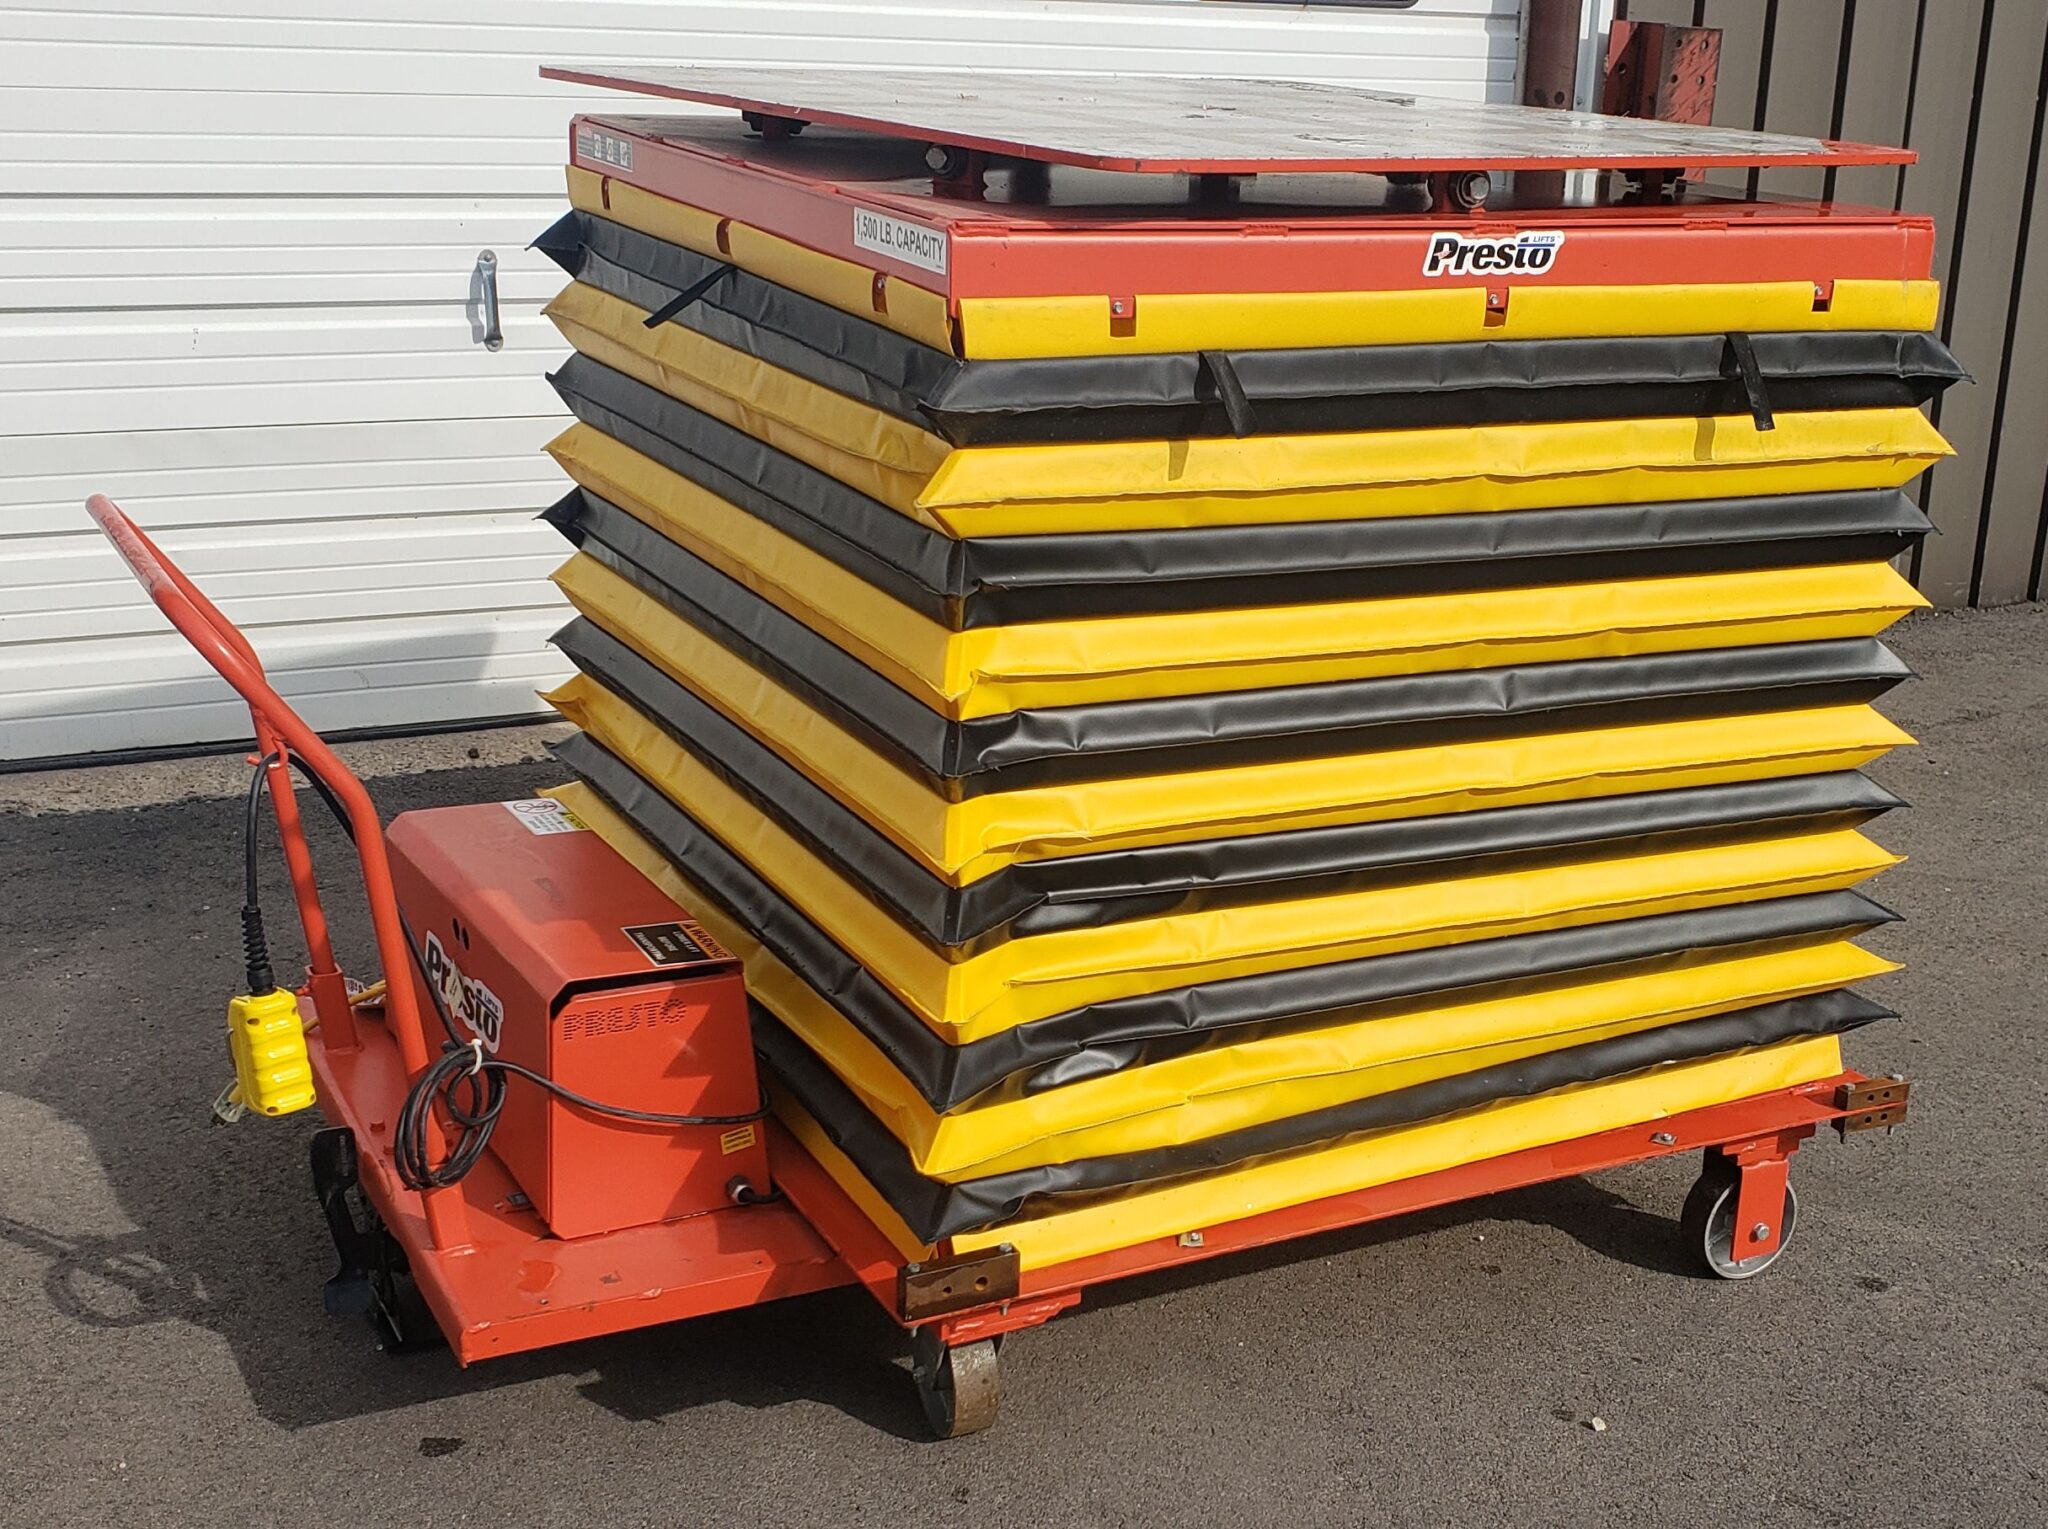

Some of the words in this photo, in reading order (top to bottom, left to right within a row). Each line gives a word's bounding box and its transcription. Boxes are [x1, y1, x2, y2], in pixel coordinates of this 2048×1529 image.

[856, 213, 878, 241] 1,500
[880, 220, 895, 246] LB.
[896, 226, 944, 262] CAPACITY
[1428, 236, 1552, 272] Presto
[1533, 235, 1556, 243] LIFTS
[427, 938, 498, 1044] Prsto
[563, 998, 687, 1040] PRESTO
